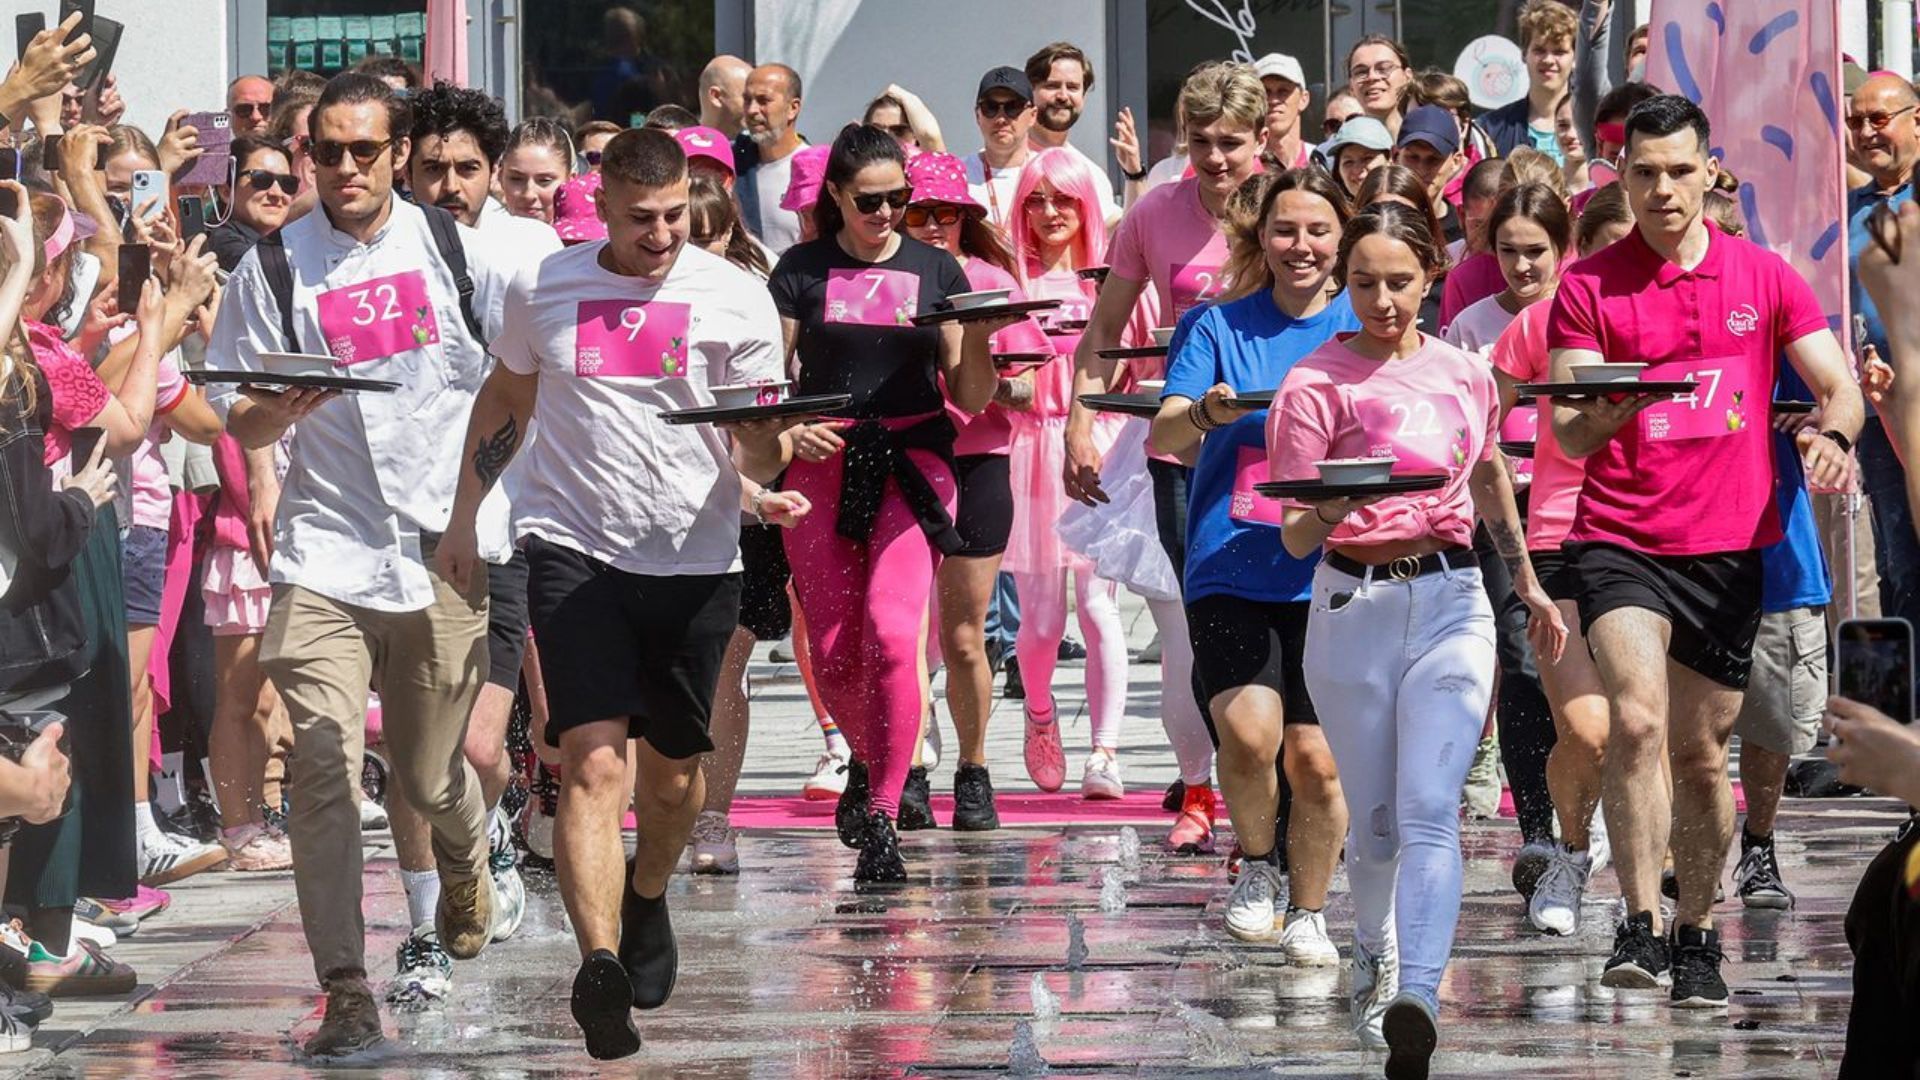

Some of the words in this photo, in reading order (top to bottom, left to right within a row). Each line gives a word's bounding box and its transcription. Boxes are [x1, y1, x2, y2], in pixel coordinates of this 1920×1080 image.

[347, 284, 403, 326] 32
[864, 274, 885, 300] 7
[620, 306, 647, 342] 9
[764, 391, 774, 404] 9
[1672, 368, 1723, 410] 47
[1389, 400, 1443, 436] 22
